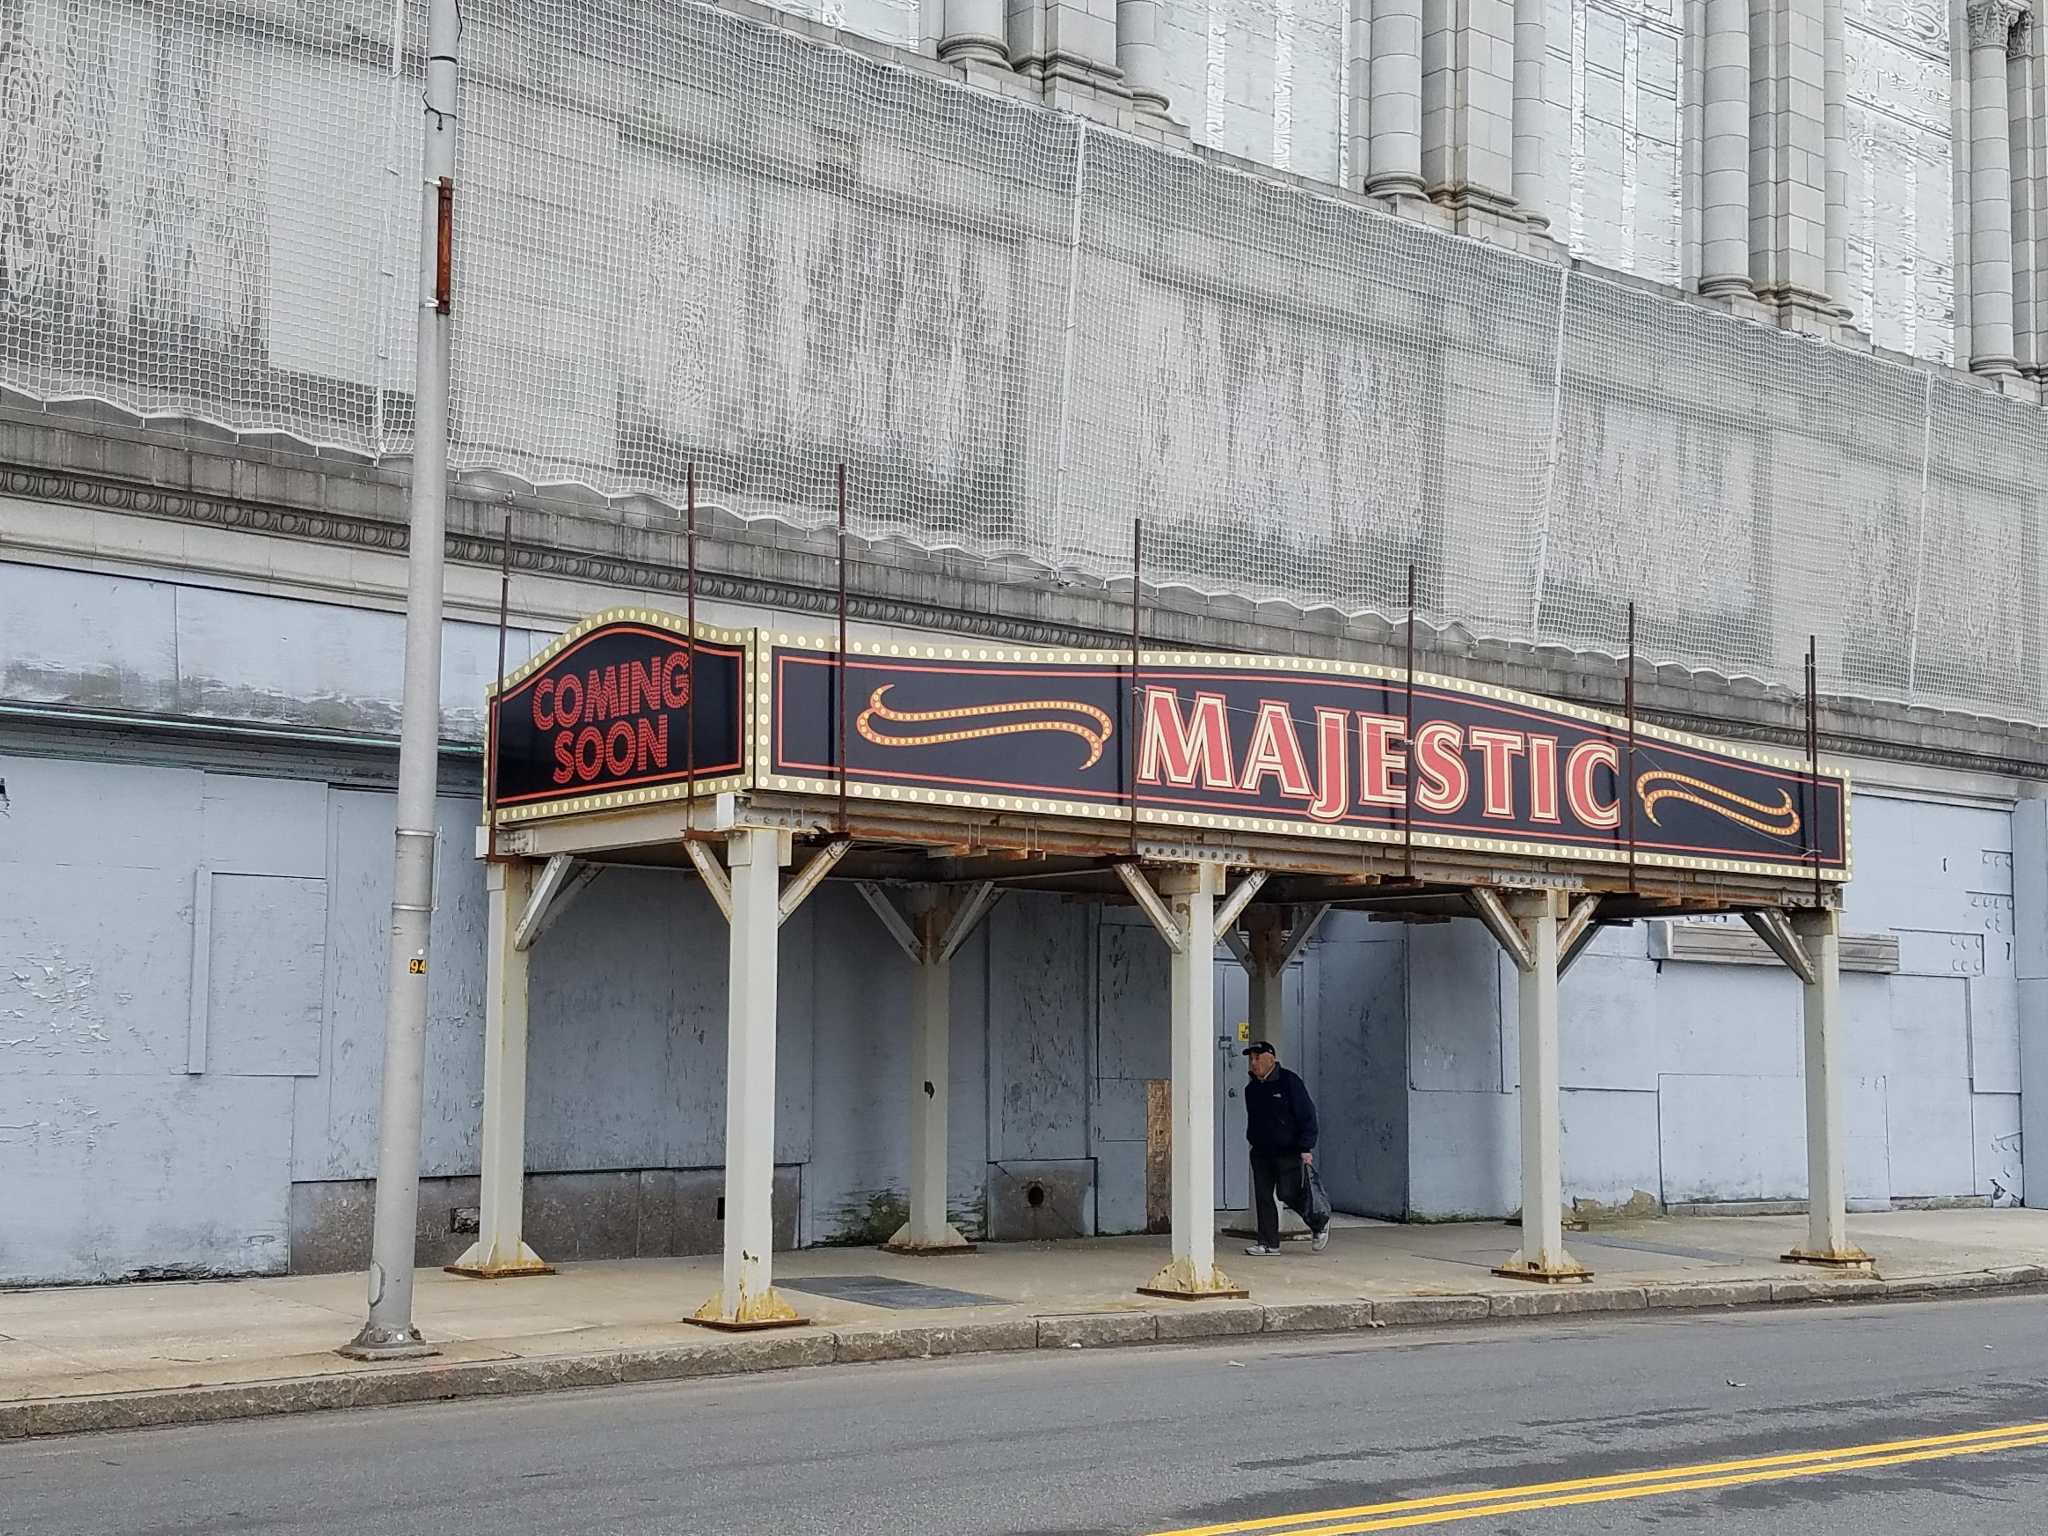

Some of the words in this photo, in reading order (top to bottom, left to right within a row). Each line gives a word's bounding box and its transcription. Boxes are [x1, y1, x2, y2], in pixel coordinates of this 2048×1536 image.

[533, 652, 690, 730] COMING
[553, 714, 668, 784] SOON
[1137, 686, 1622, 829] MAJESTIC
[410, 959, 426, 974] 94
